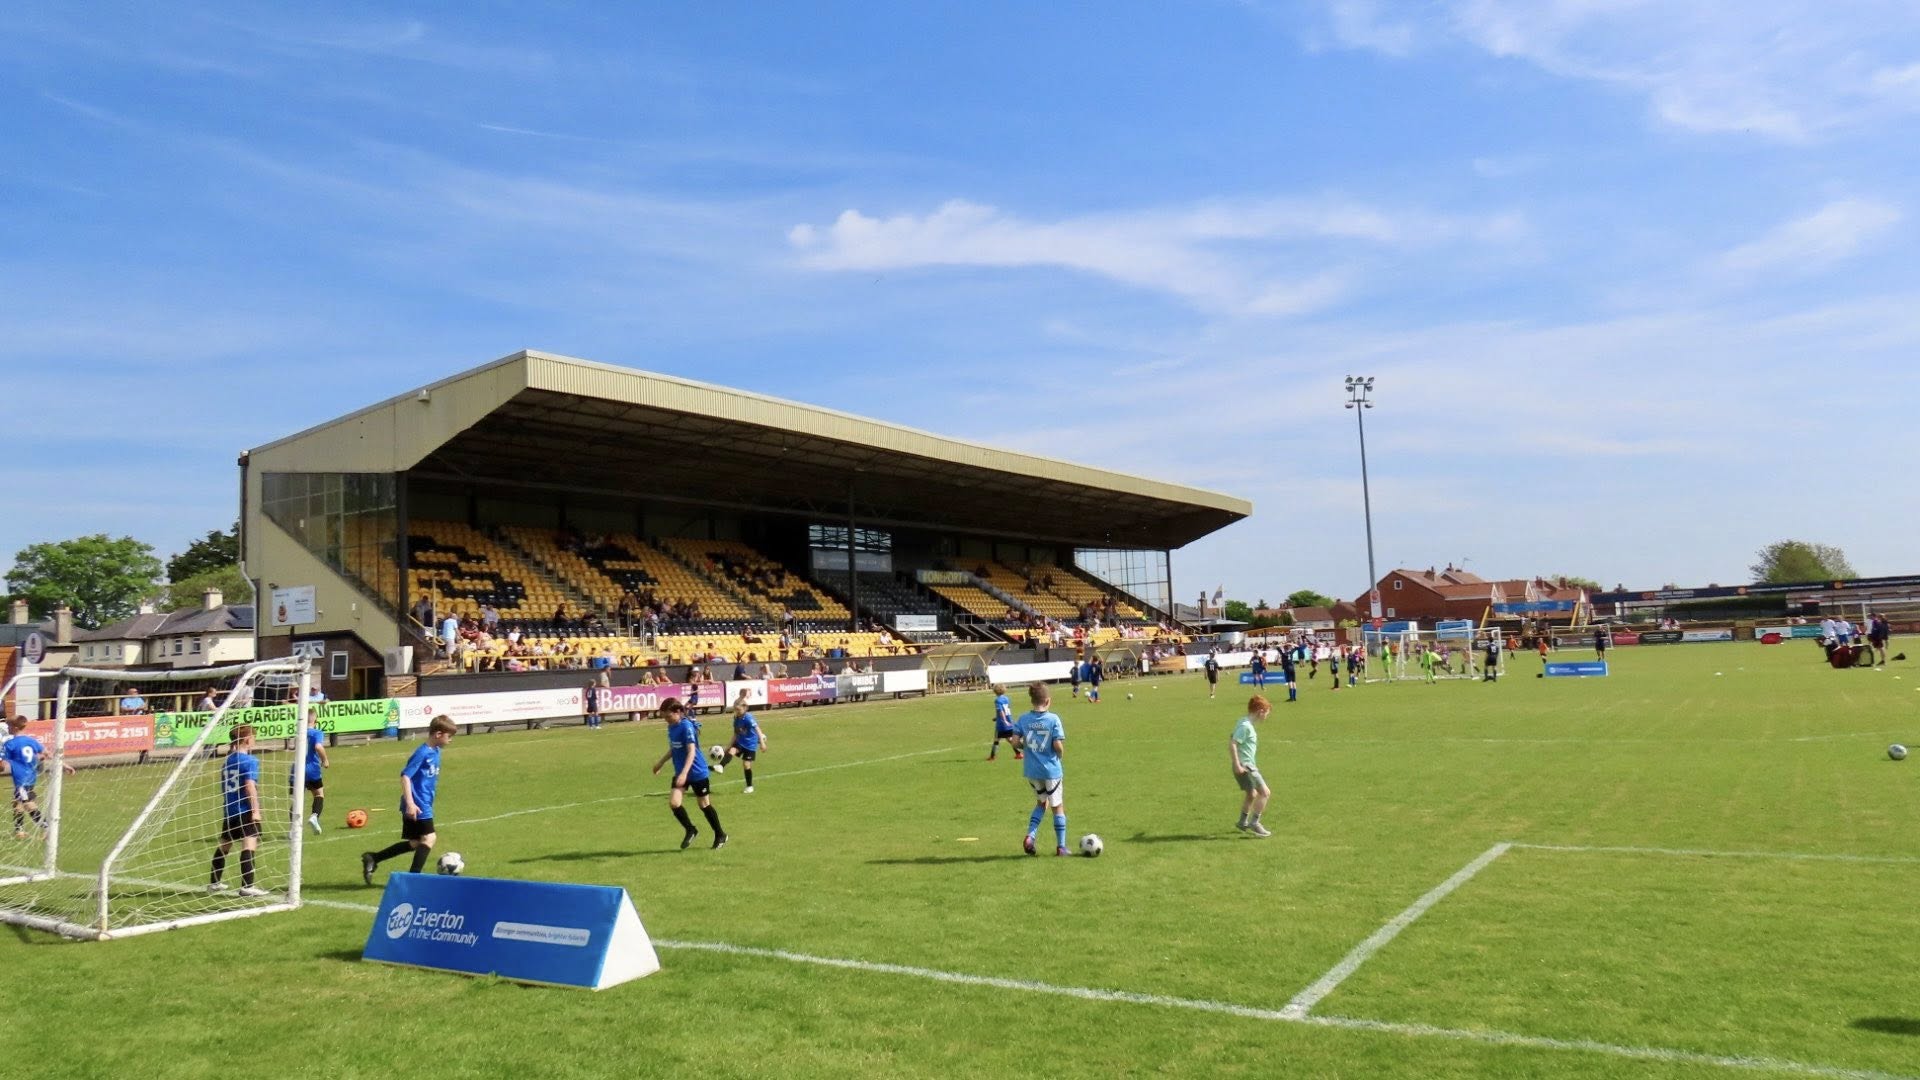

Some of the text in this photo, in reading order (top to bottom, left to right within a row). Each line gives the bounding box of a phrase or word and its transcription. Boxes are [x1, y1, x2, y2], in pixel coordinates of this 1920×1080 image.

[779, 683, 804, 692] National
[852, 675, 879, 686] UNIBET
[601, 687, 657, 711] Barron
[243, 707, 296, 723] GARDEN
[308, 701, 384, 718] AINTENANCE
[405, 706, 422, 716] real
[93, 729, 118, 740] 374
[120, 727, 149, 738] 2151
[252, 724, 283, 737] 7909
[1026, 730, 1050, 752] 47
[21, 746, 34, 763] 9
[413, 907, 465, 930] Everton
[409, 927, 479, 947] in the Community
